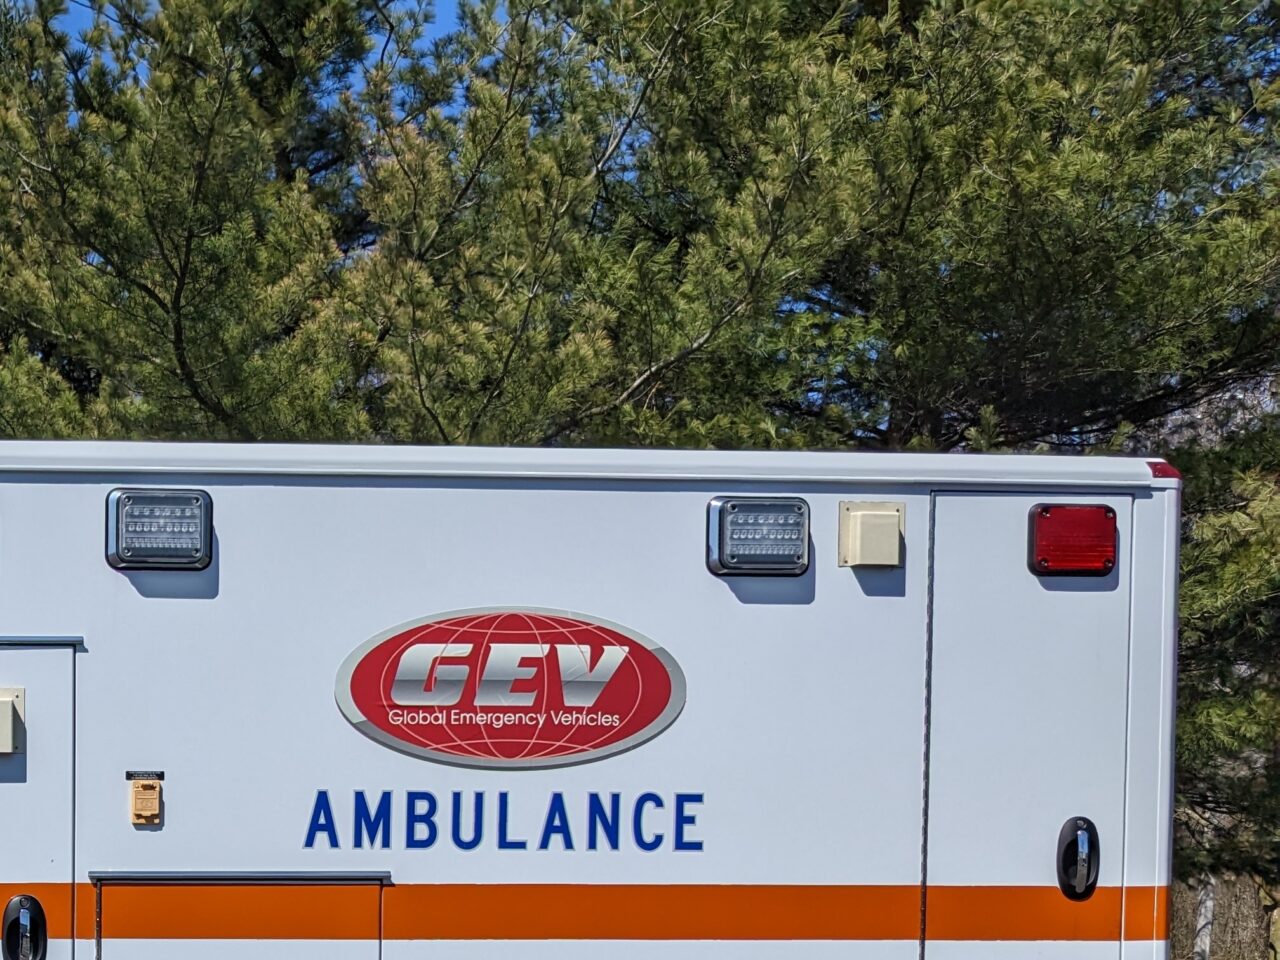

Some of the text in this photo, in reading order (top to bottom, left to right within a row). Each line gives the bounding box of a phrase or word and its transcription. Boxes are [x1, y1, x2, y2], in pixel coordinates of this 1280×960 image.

[390, 643, 630, 707] GEV
[388, 709, 620, 729] Global Emergency Vehicles
[302, 789, 705, 852] AMBULANCE
